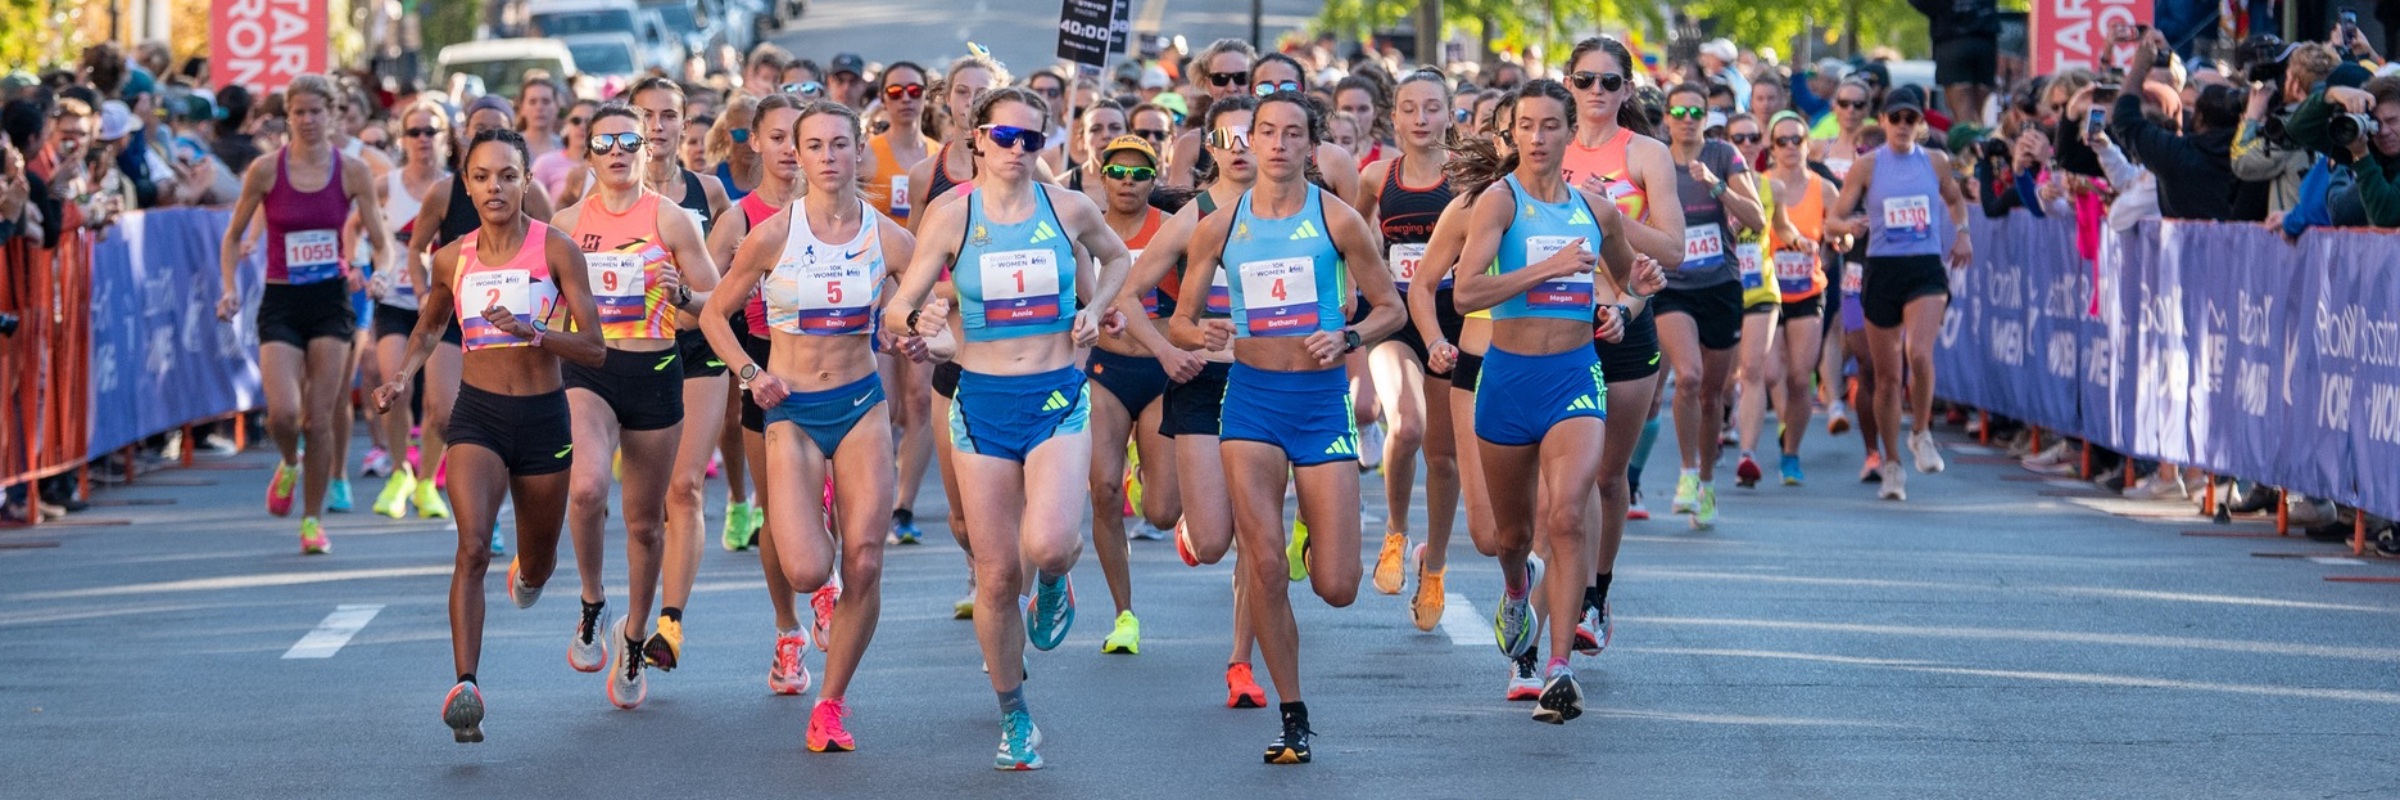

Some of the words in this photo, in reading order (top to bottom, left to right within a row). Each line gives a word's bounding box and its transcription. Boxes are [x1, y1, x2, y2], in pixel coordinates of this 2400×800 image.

[1060, 19, 1109, 41] 40:00
[1117, 136, 1148, 149] HOKA
[292, 244, 333, 262] 1055
[1688, 236, 1719, 256] 443
[998, 260, 1027, 268] WOMEN
[813, 271, 843, 279] WOMEN
[1257, 269, 1285, 277] WOMEN
[602, 270, 618, 292] 9
[1012, 269, 1025, 293] 1
[827, 281, 843, 304] 5
[1271, 278, 1287, 302] 4
[486, 288, 500, 311] 2
[1550, 294, 1573, 303] Megan
[1012, 309, 1033, 318] Annie
[826, 319, 847, 328] Emily
[1268, 319, 1298, 328] Bethany
